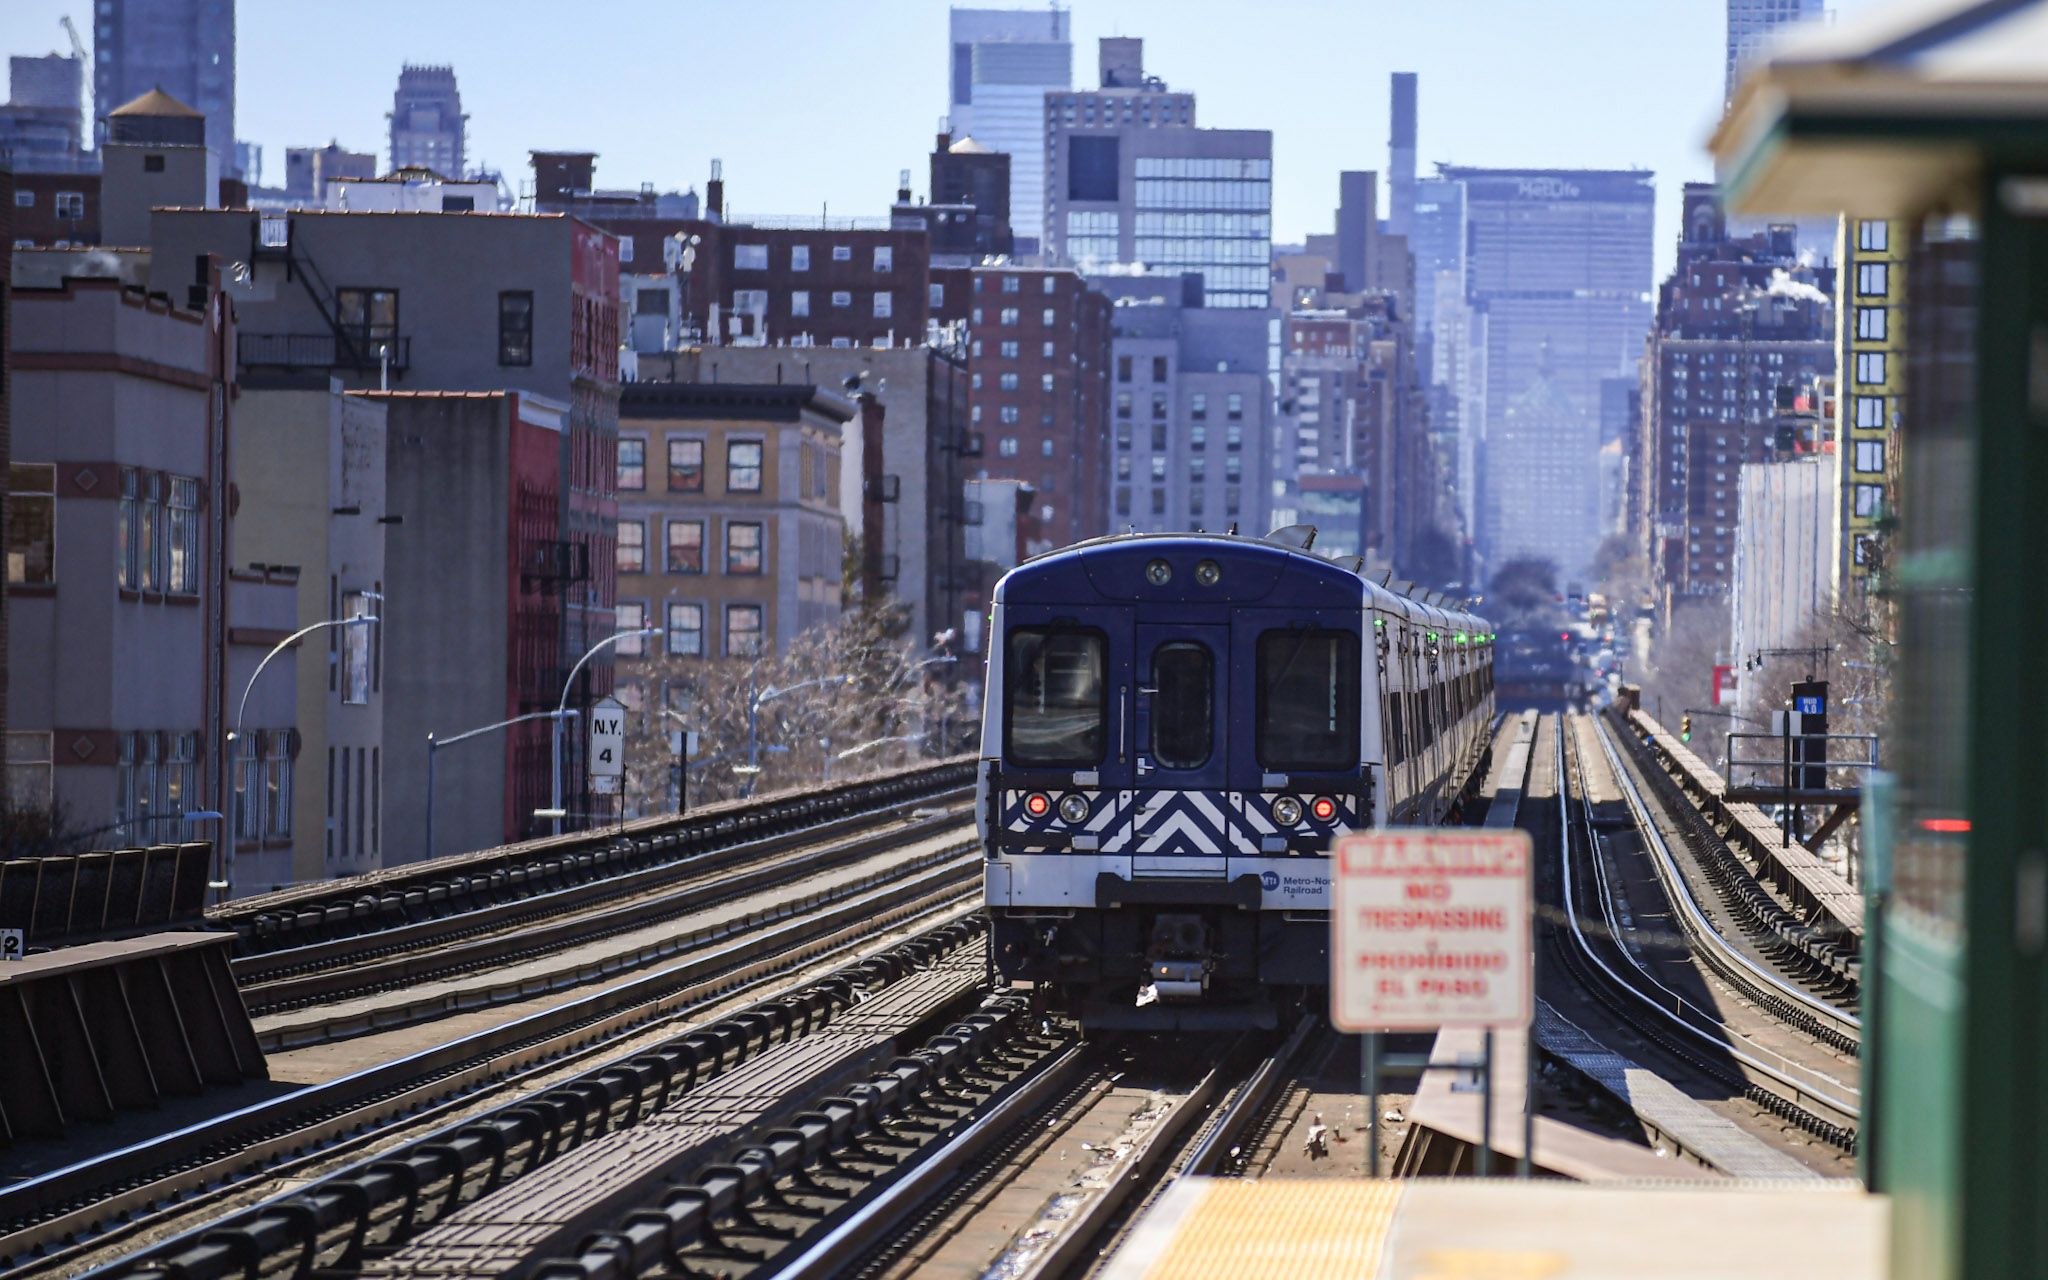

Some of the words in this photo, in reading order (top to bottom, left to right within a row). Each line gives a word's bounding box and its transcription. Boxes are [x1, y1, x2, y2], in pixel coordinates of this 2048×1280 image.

[1518, 179, 1581, 197] MetLife
[1804, 705, 1817, 714] 4.0
[594, 719, 621, 736] N.Y.
[599, 749, 612, 763] 4
[1283, 877, 1331, 885] Metro-Nor
[1283, 886, 1322, 895] Railroad
[1405, 883, 1451, 902] NO
[1359, 908, 1507, 930] TRESPASSING
[0, 935, 19, 953] 2
[1378, 979, 1405, 996] EL
[1418, 978, 1488, 996] PASO
